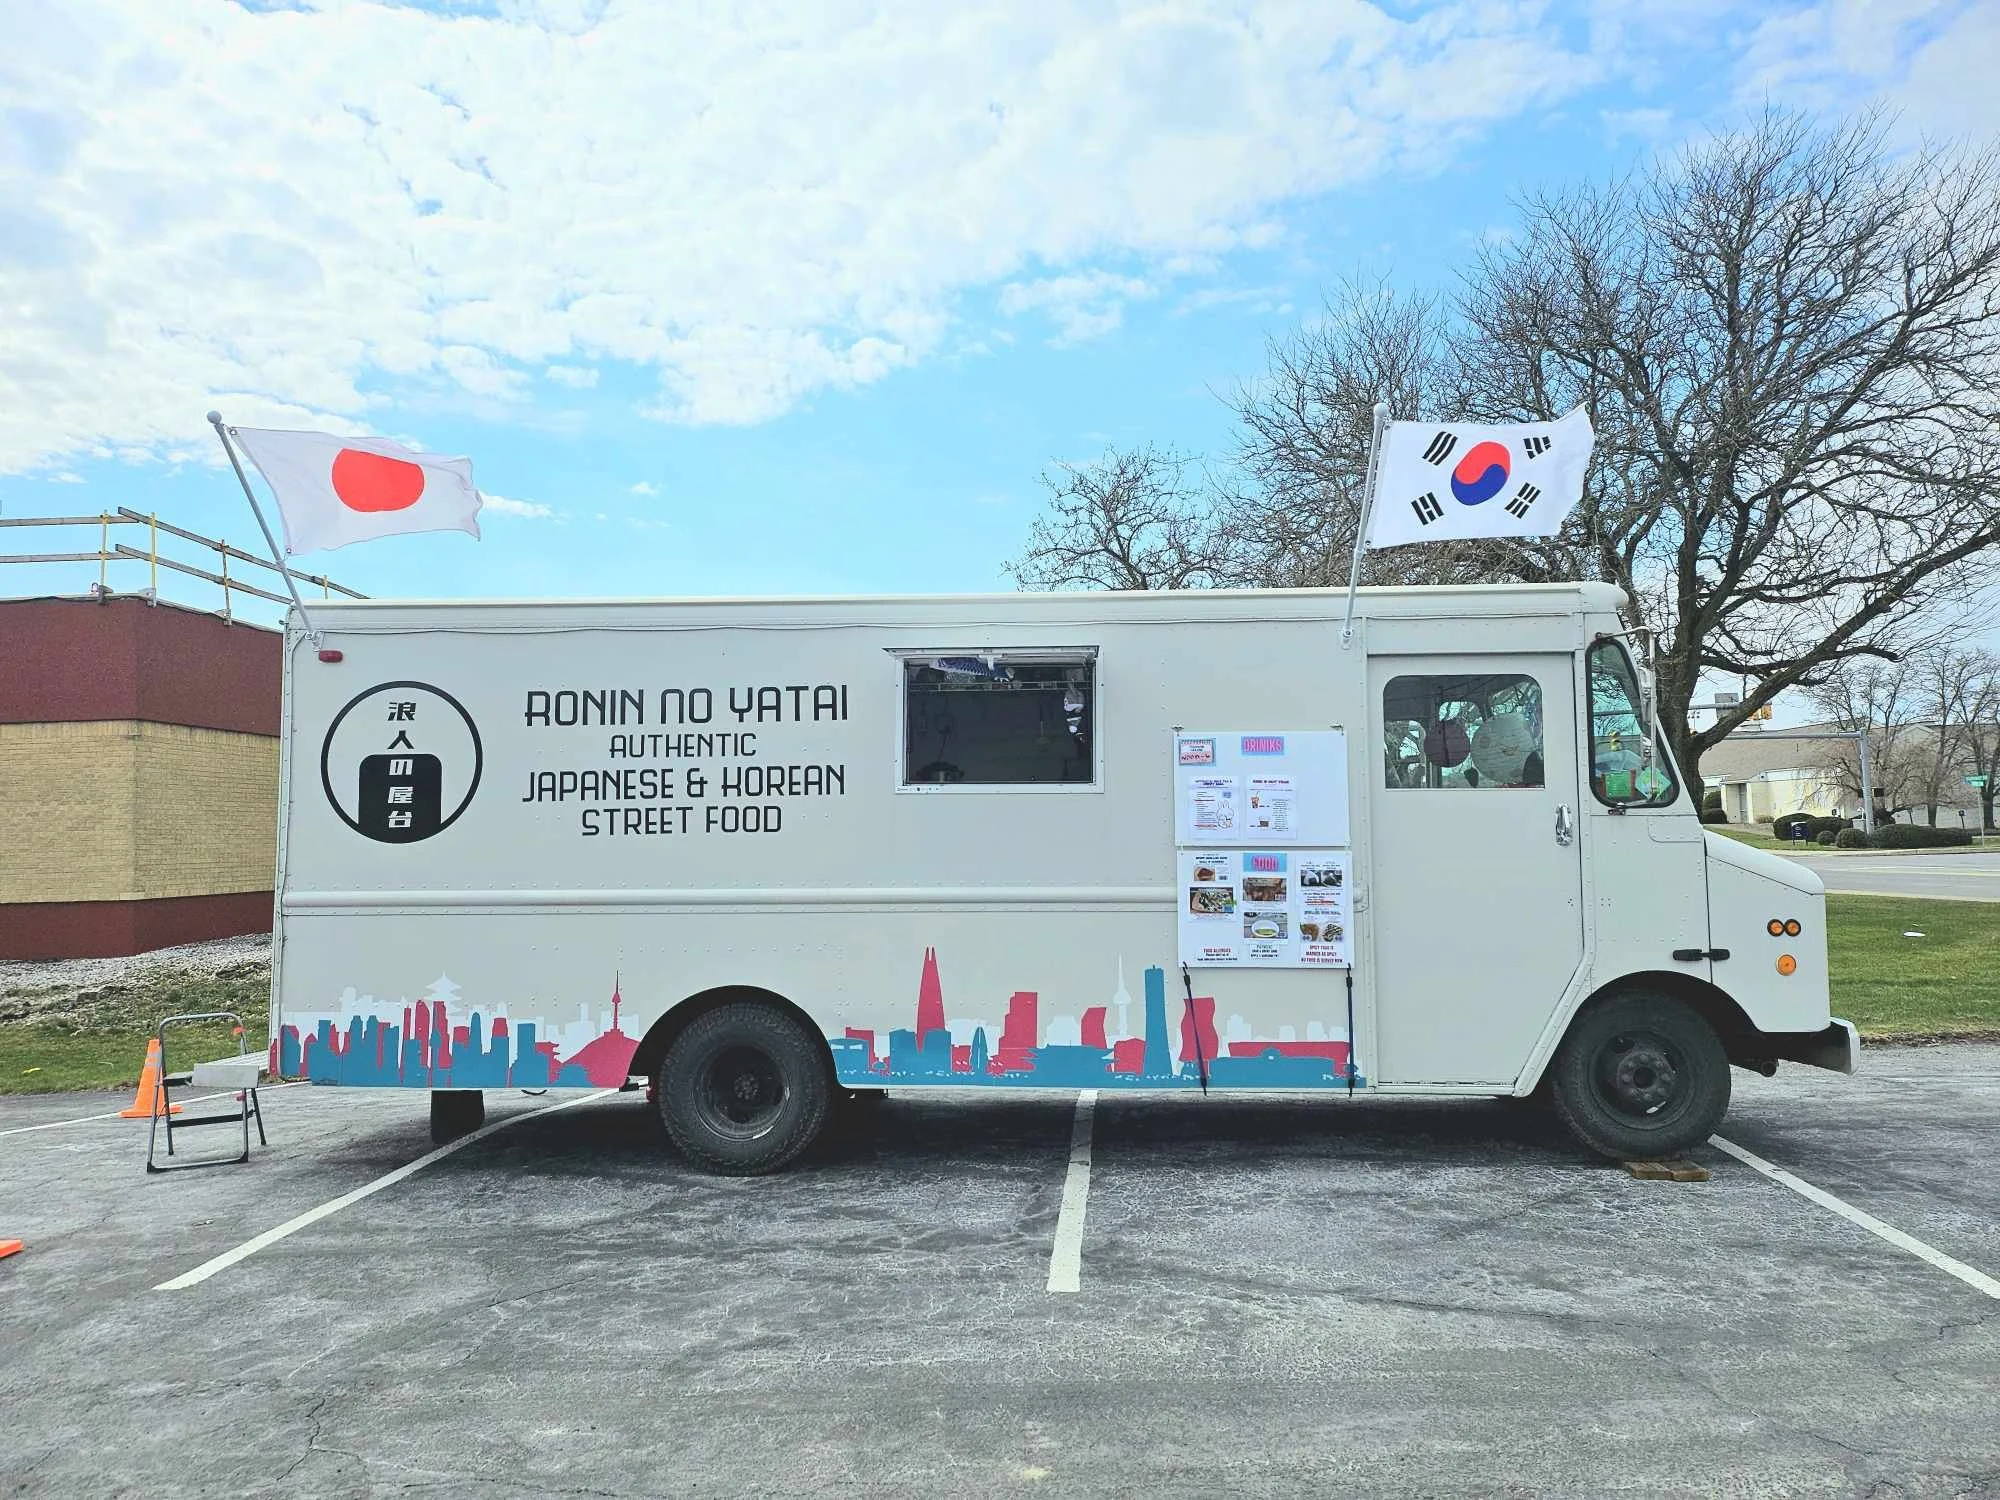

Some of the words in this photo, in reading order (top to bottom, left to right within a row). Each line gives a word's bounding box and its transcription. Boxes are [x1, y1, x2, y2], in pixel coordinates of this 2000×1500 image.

[524, 688, 644, 727] RONIN
[660, 688, 713, 725] NO
[729, 684, 848, 724] YATAI
[609, 732, 757, 759] AUTHENTIC
[1244, 738, 1283, 753] DRINKS
[387, 701, 417, 828] 浪人の屋台
[522, 769, 675, 803] JAPANESE
[686, 767, 708, 799] &
[721, 764, 845, 798] KOREAN
[581, 806, 694, 836] STREET
[705, 805, 783, 833] FOOD
